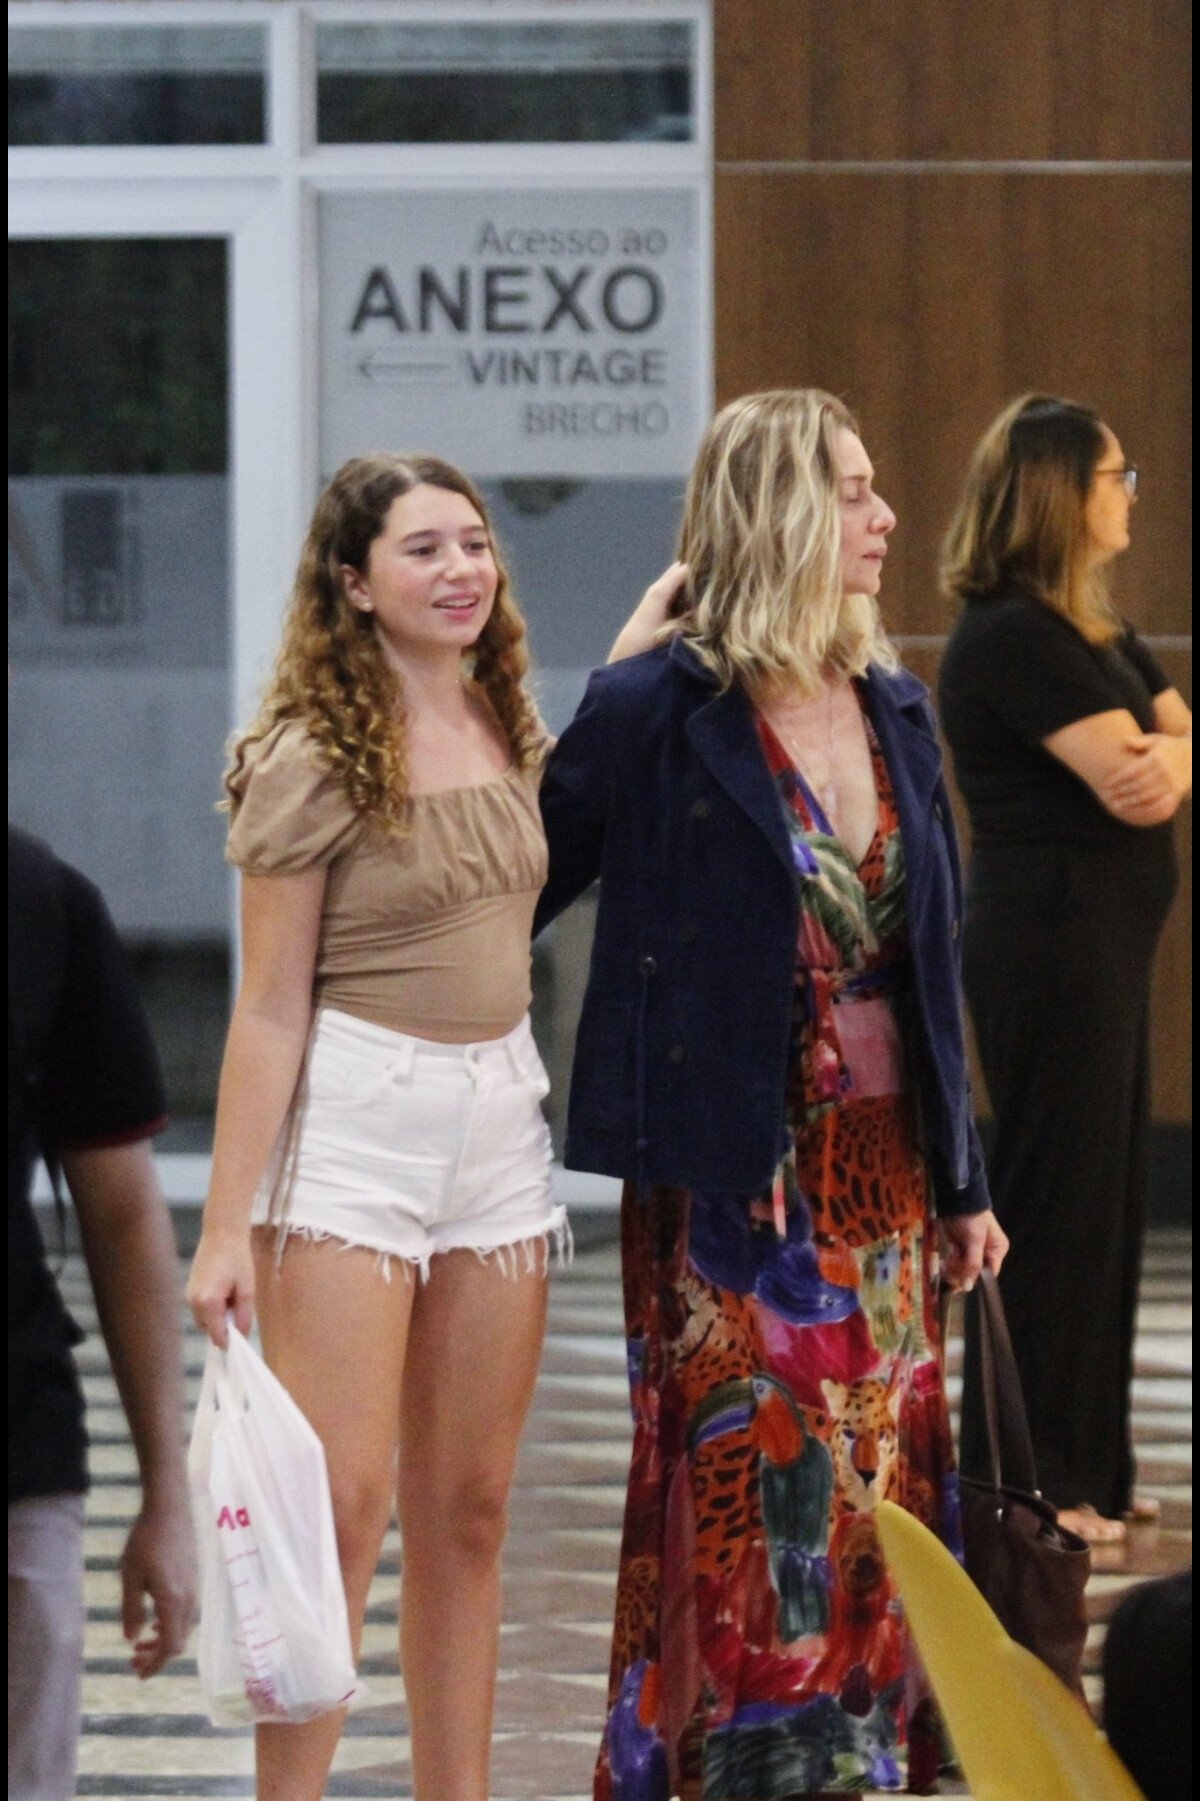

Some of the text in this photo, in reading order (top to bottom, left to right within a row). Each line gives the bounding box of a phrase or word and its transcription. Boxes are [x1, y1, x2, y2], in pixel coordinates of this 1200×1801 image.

[478, 221, 668, 256] Acesso ao
[350, 264, 666, 334] ANEXO
[464, 349, 668, 388] VINTAGE
